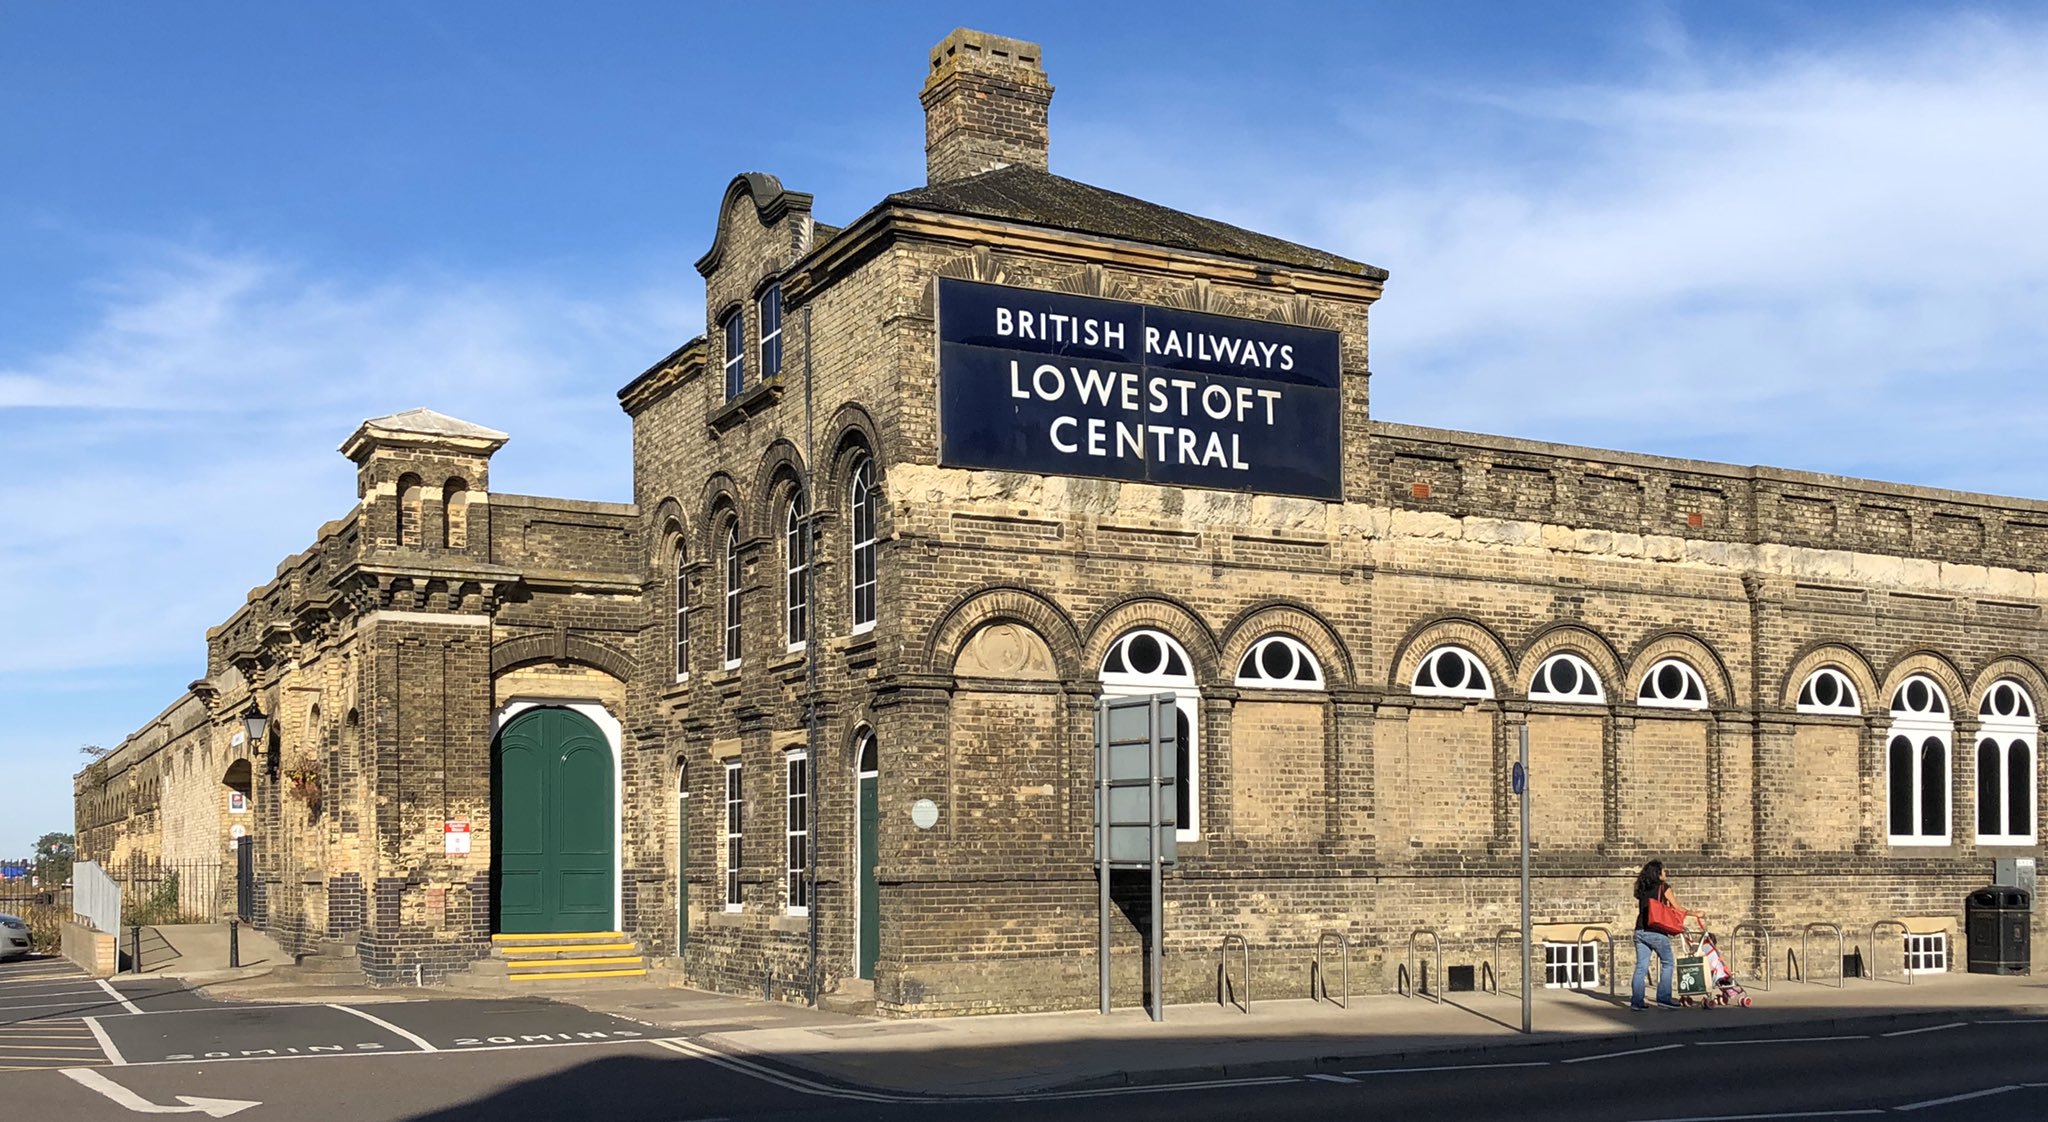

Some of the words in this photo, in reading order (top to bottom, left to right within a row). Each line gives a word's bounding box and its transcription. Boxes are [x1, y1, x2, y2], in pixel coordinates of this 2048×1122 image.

[997, 308, 1125, 350] BRITISH
[1146, 327, 1294, 371] RAILWAYS
[1010, 361, 1282, 426] LOWESTOFT
[1050, 416, 1249, 471] CENTRAL
